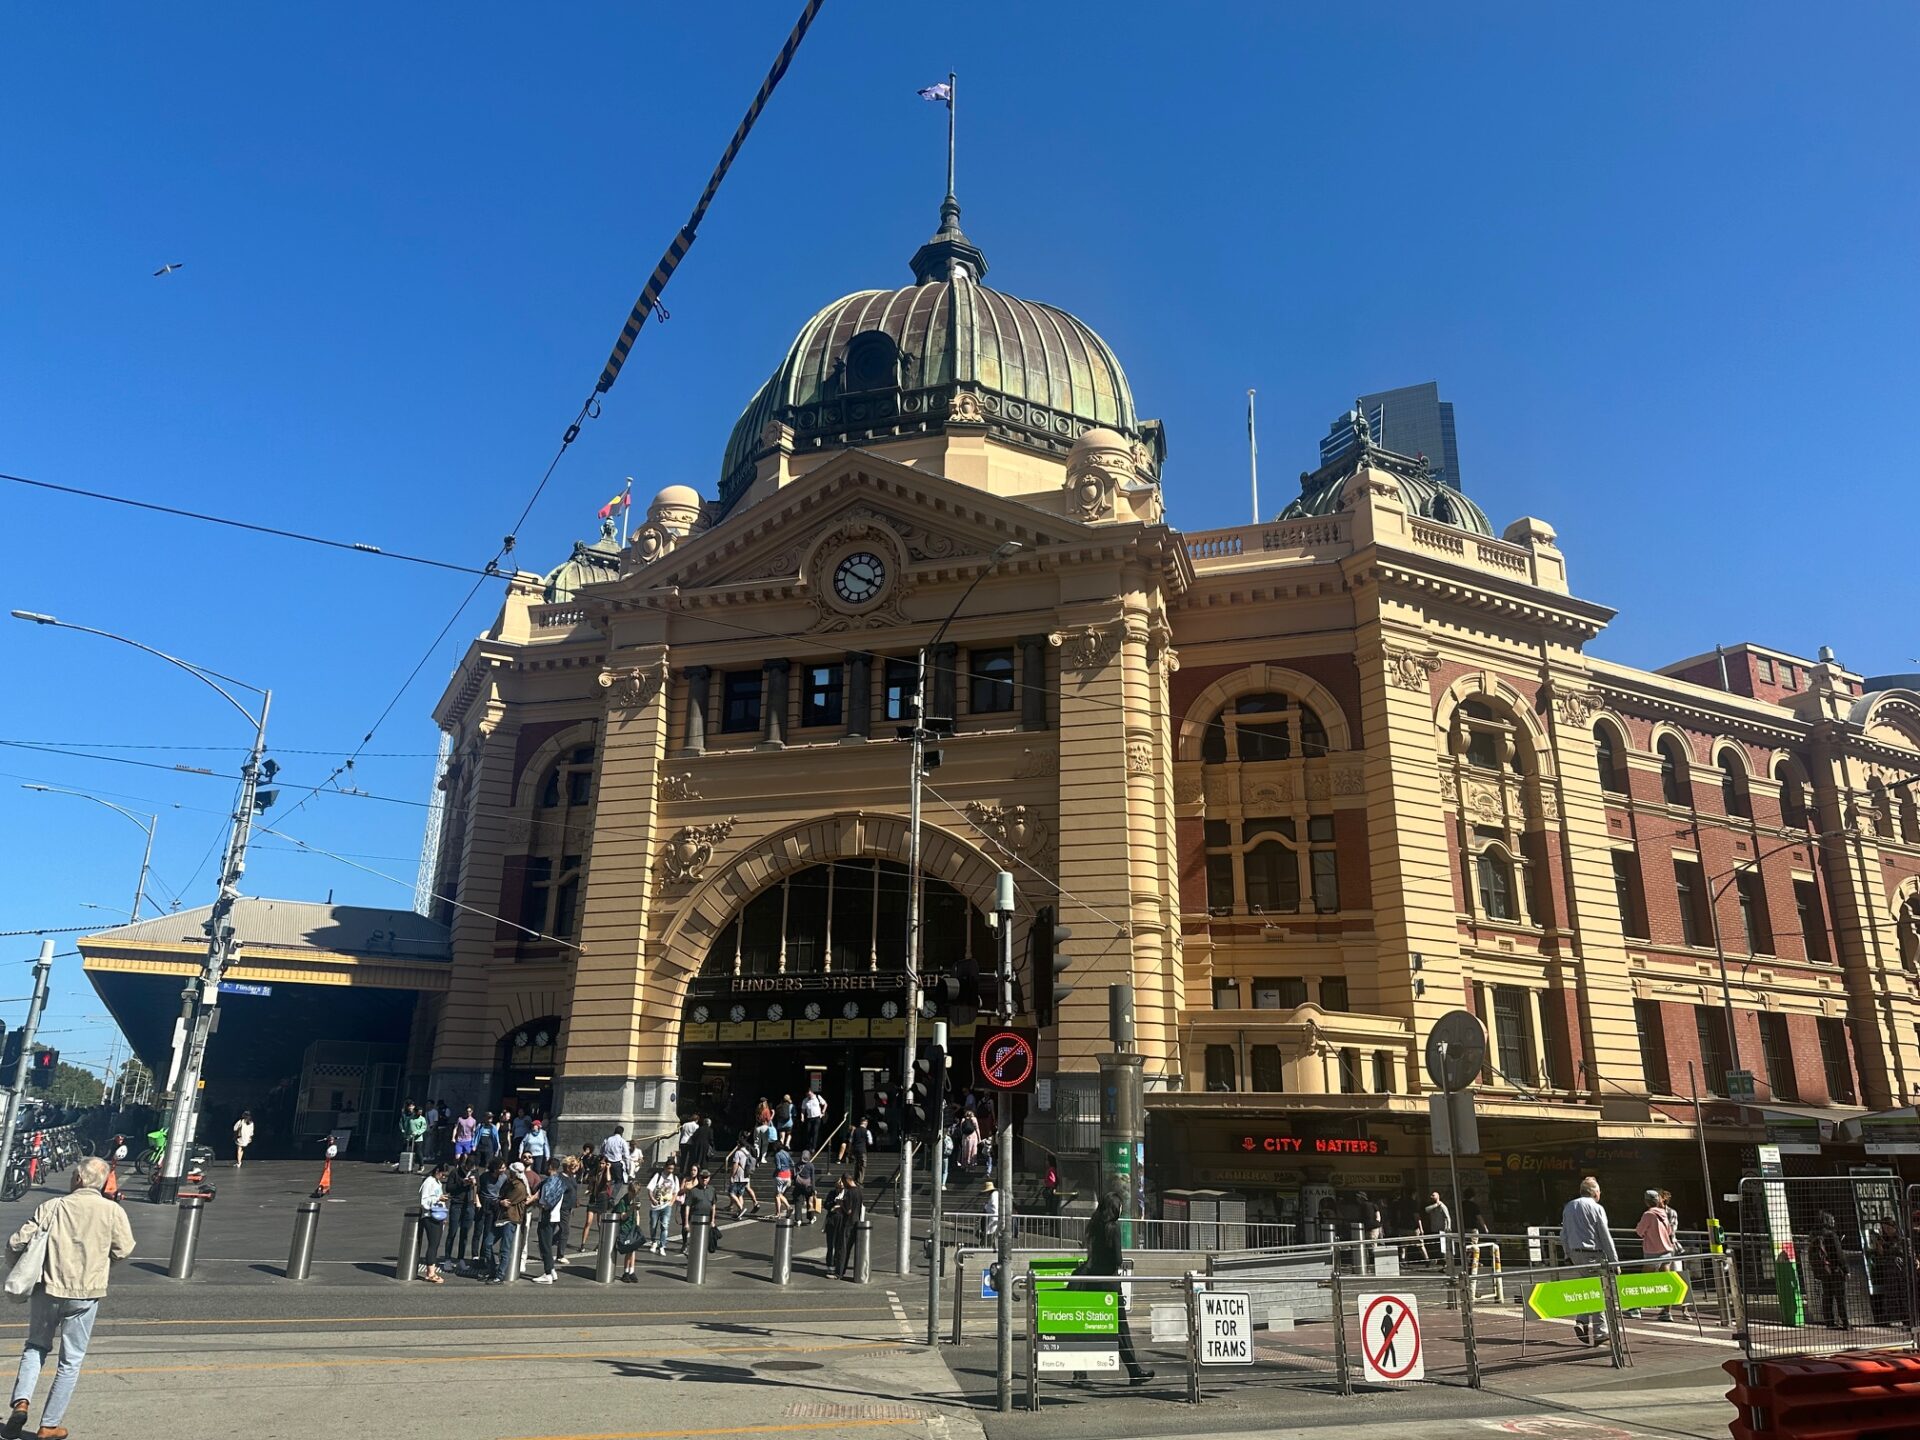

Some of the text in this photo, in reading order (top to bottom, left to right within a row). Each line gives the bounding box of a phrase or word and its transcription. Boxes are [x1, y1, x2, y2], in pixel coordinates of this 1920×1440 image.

[235, 984, 261, 993] Flinders
[731, 978, 803, 992] FLINDERS
[821, 975, 878, 990] STREET
[1263, 1138, 1378, 1153] CITY HATTERS
[1597, 1150, 1640, 1160] EzyMart
[1521, 1156, 1574, 1173] EzyMart
[1564, 1289, 1600, 1303] You're in the
[1625, 1284, 1670, 1296] FREE TRAM ZONE
[1206, 1299, 1244, 1315] WATCH
[1042, 1310, 1114, 1321] Flinders St Station
[1216, 1320, 1237, 1336] FOR
[1208, 1341, 1246, 1357] TRAMS
[1108, 1356, 1115, 1367] 5
